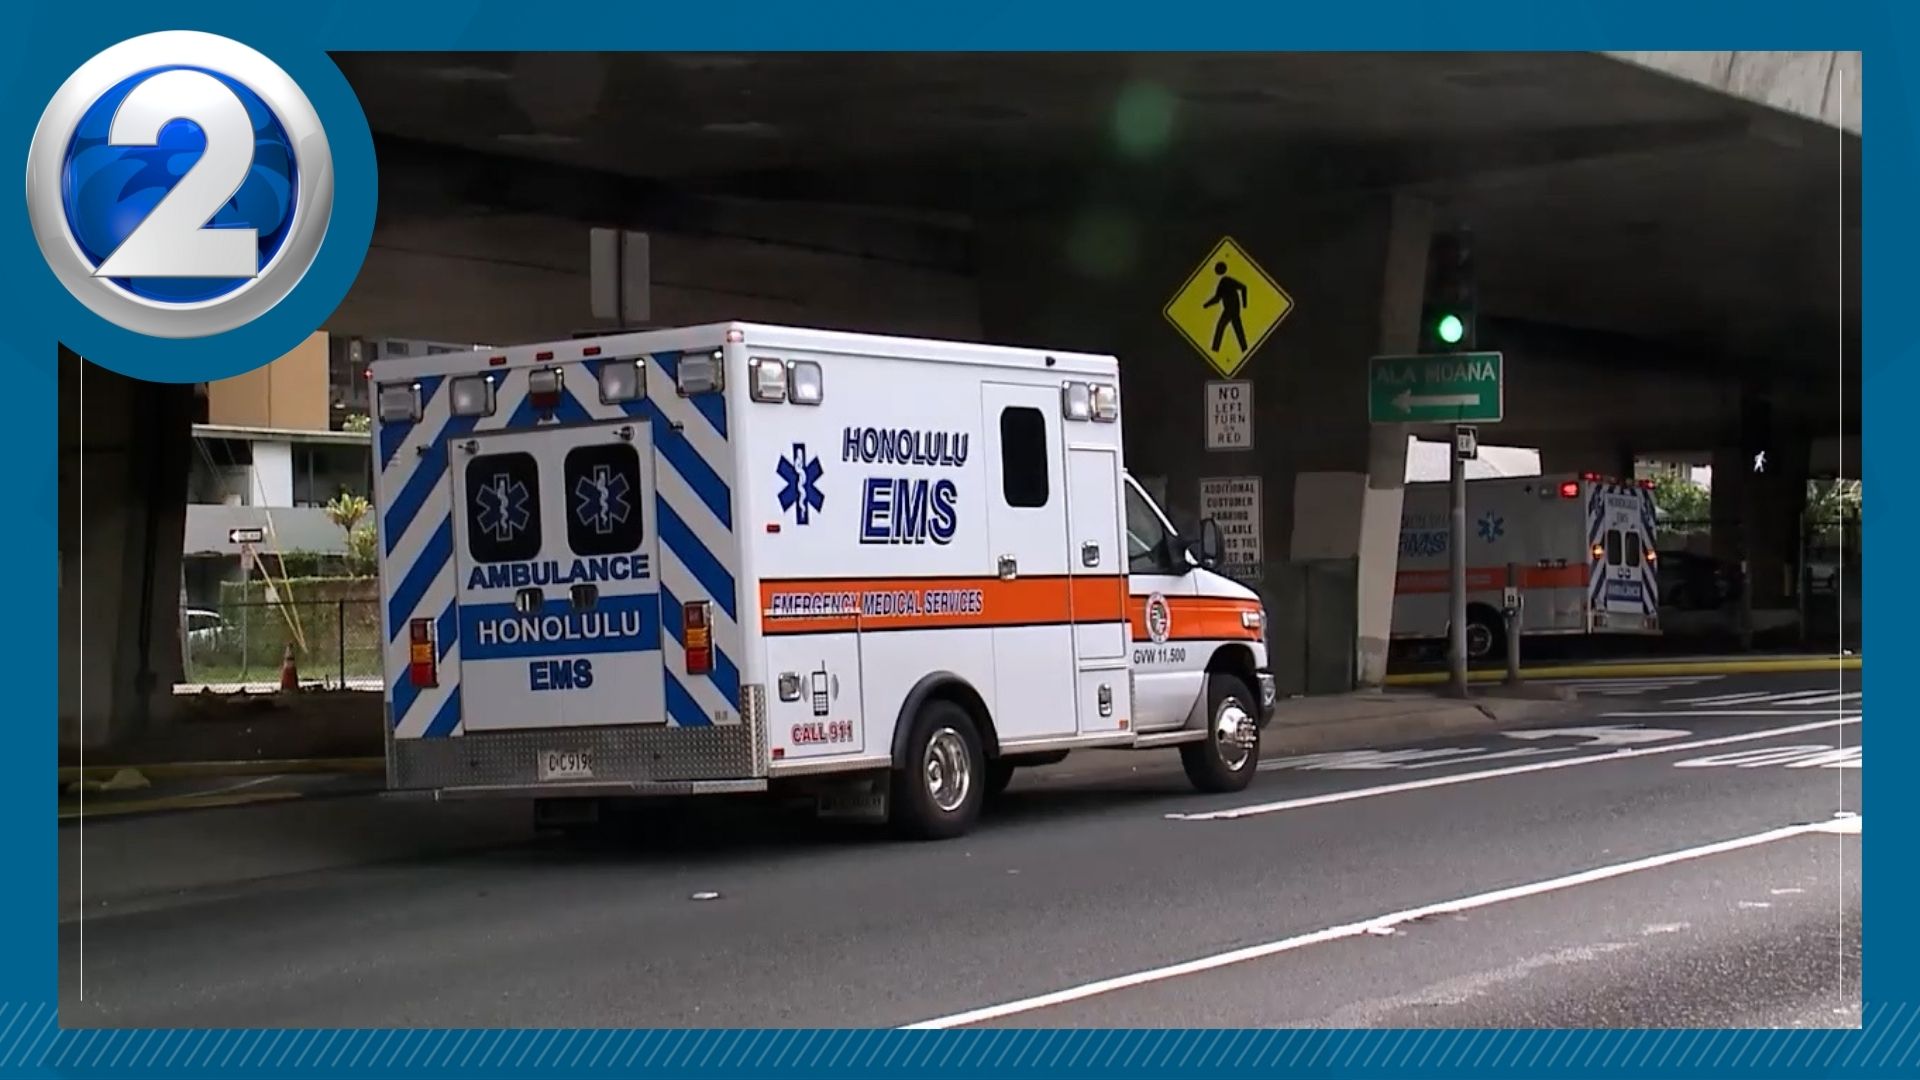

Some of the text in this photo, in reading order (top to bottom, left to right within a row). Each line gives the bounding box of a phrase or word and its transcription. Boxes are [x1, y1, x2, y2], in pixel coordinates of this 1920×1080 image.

[1376, 362, 1496, 382] ALA MOANA
[1218, 387, 1240, 400] NO
[1215, 402, 1241, 413] LEFT
[1214, 414, 1245, 424] TURN
[842, 427, 969, 467] HONOLULU
[1217, 432, 1241, 444] RED
[1204, 483, 1254, 493] ADDITIONAL
[859, 478, 958, 545] EMS
[1207, 497, 1253, 508] CUSTOMER
[467, 554, 651, 590] AMBULANCE
[771, 589, 984, 618] EMERGENCY MEDICAL SERVICES
[478, 610, 641, 645] HONOLULU
[1133, 647, 1187, 665] GVW 11,500
[530, 659, 593, 691] EMS
[791, 720, 854, 746] CALL 911
